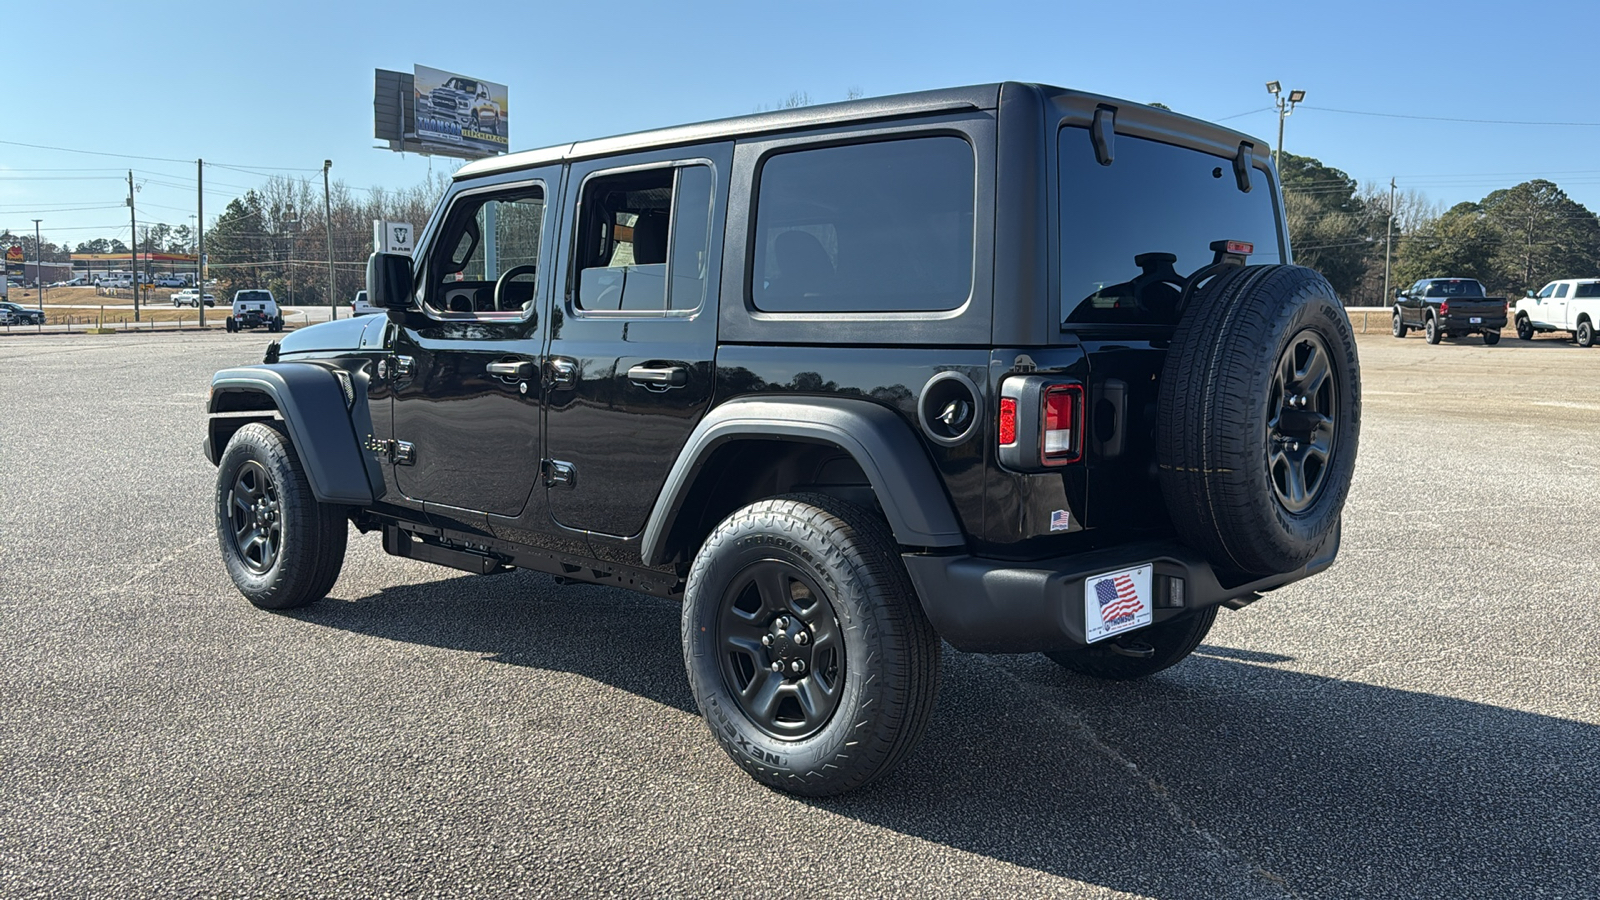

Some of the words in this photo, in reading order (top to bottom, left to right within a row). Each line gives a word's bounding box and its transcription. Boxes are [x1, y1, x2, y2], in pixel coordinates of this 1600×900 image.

[418, 117, 462, 136] THOMSON
[1110, 612, 1135, 626] THOMSON
[712, 704, 781, 766] NEXEN
